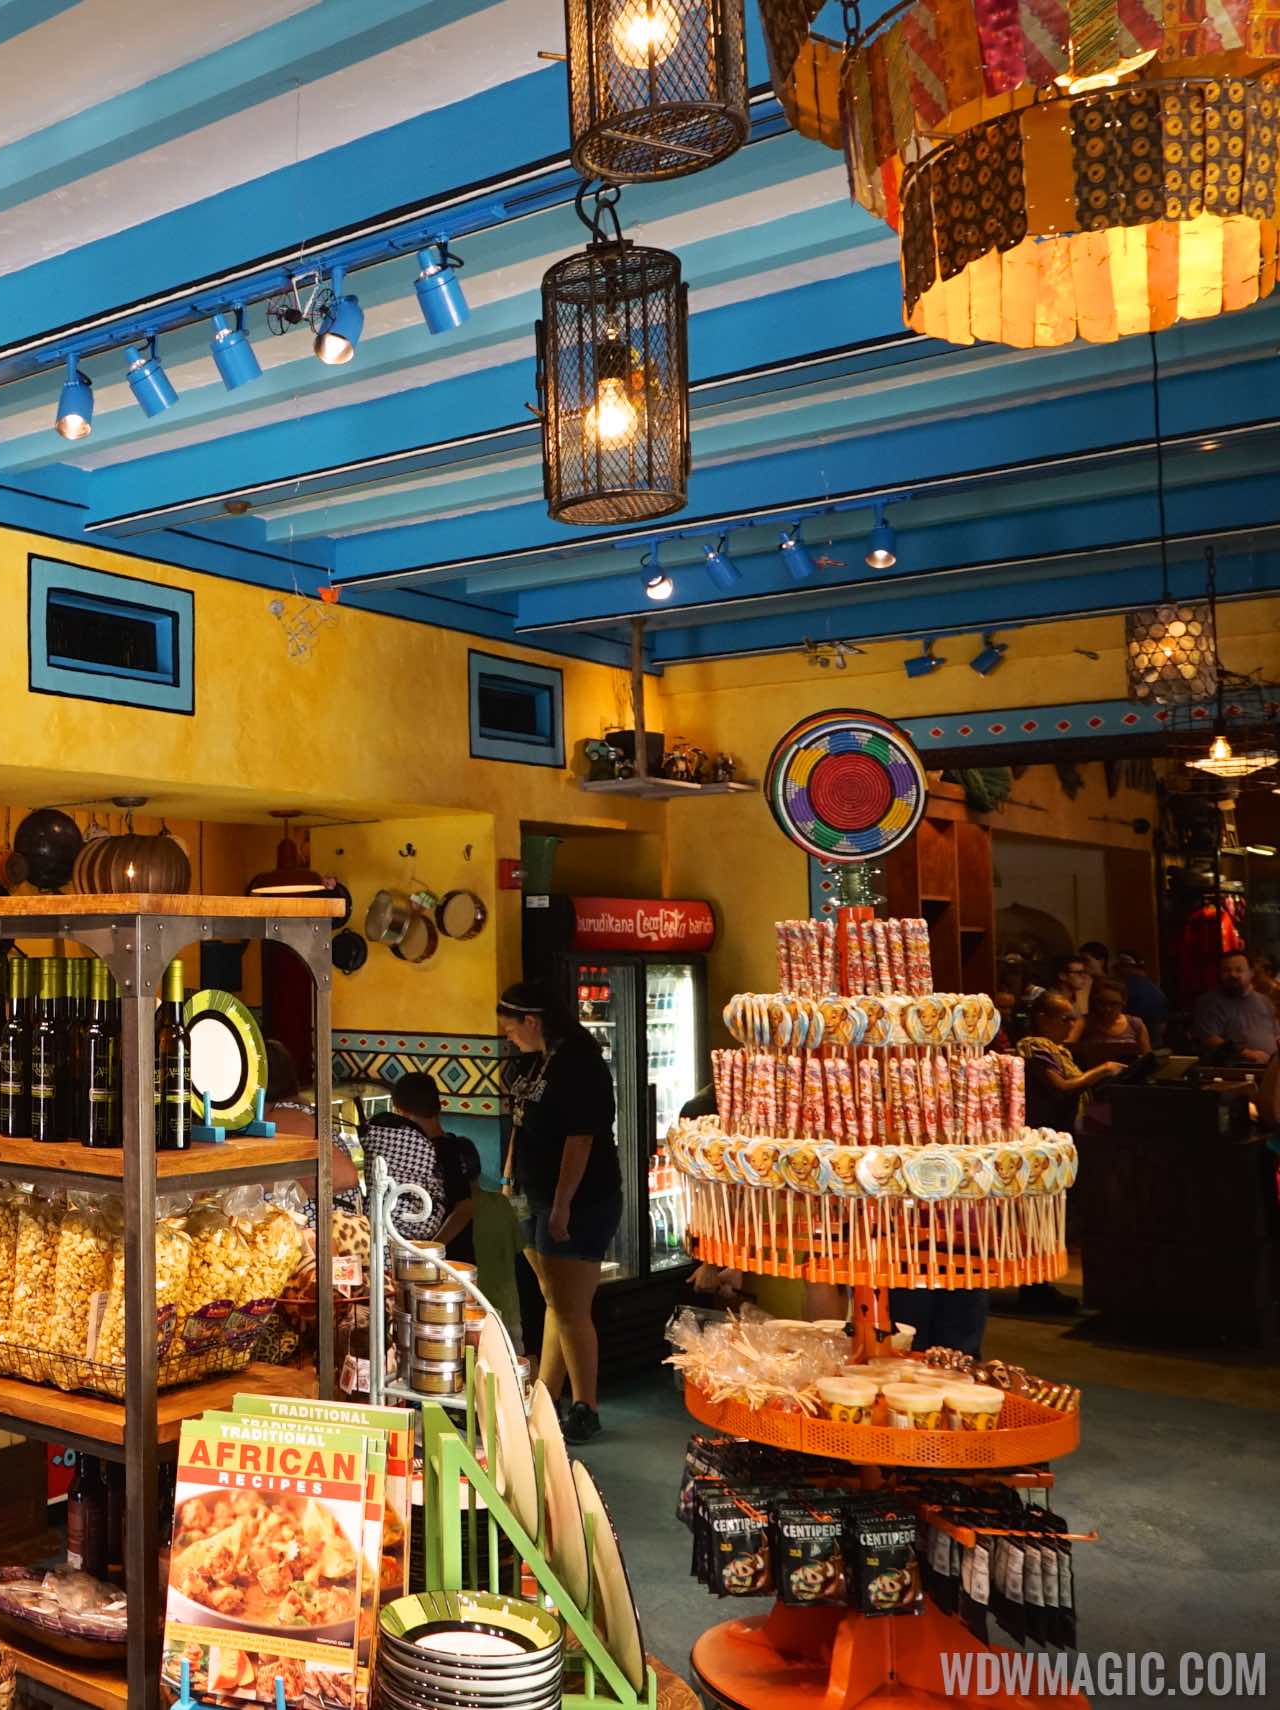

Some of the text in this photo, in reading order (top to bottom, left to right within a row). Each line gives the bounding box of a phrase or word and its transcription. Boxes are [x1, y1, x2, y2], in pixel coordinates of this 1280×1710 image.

[269, 1402, 370, 1425] TRADITIONAL
[219, 1424, 326, 1448] TRADITIONAL
[188, 1439, 355, 1481] AFRICAN
[218, 1471, 323, 1495] RECIPES
[783, 1523, 842, 1538] CENTIPEDE
[860, 1529, 915, 1546] CENTIPEDE
